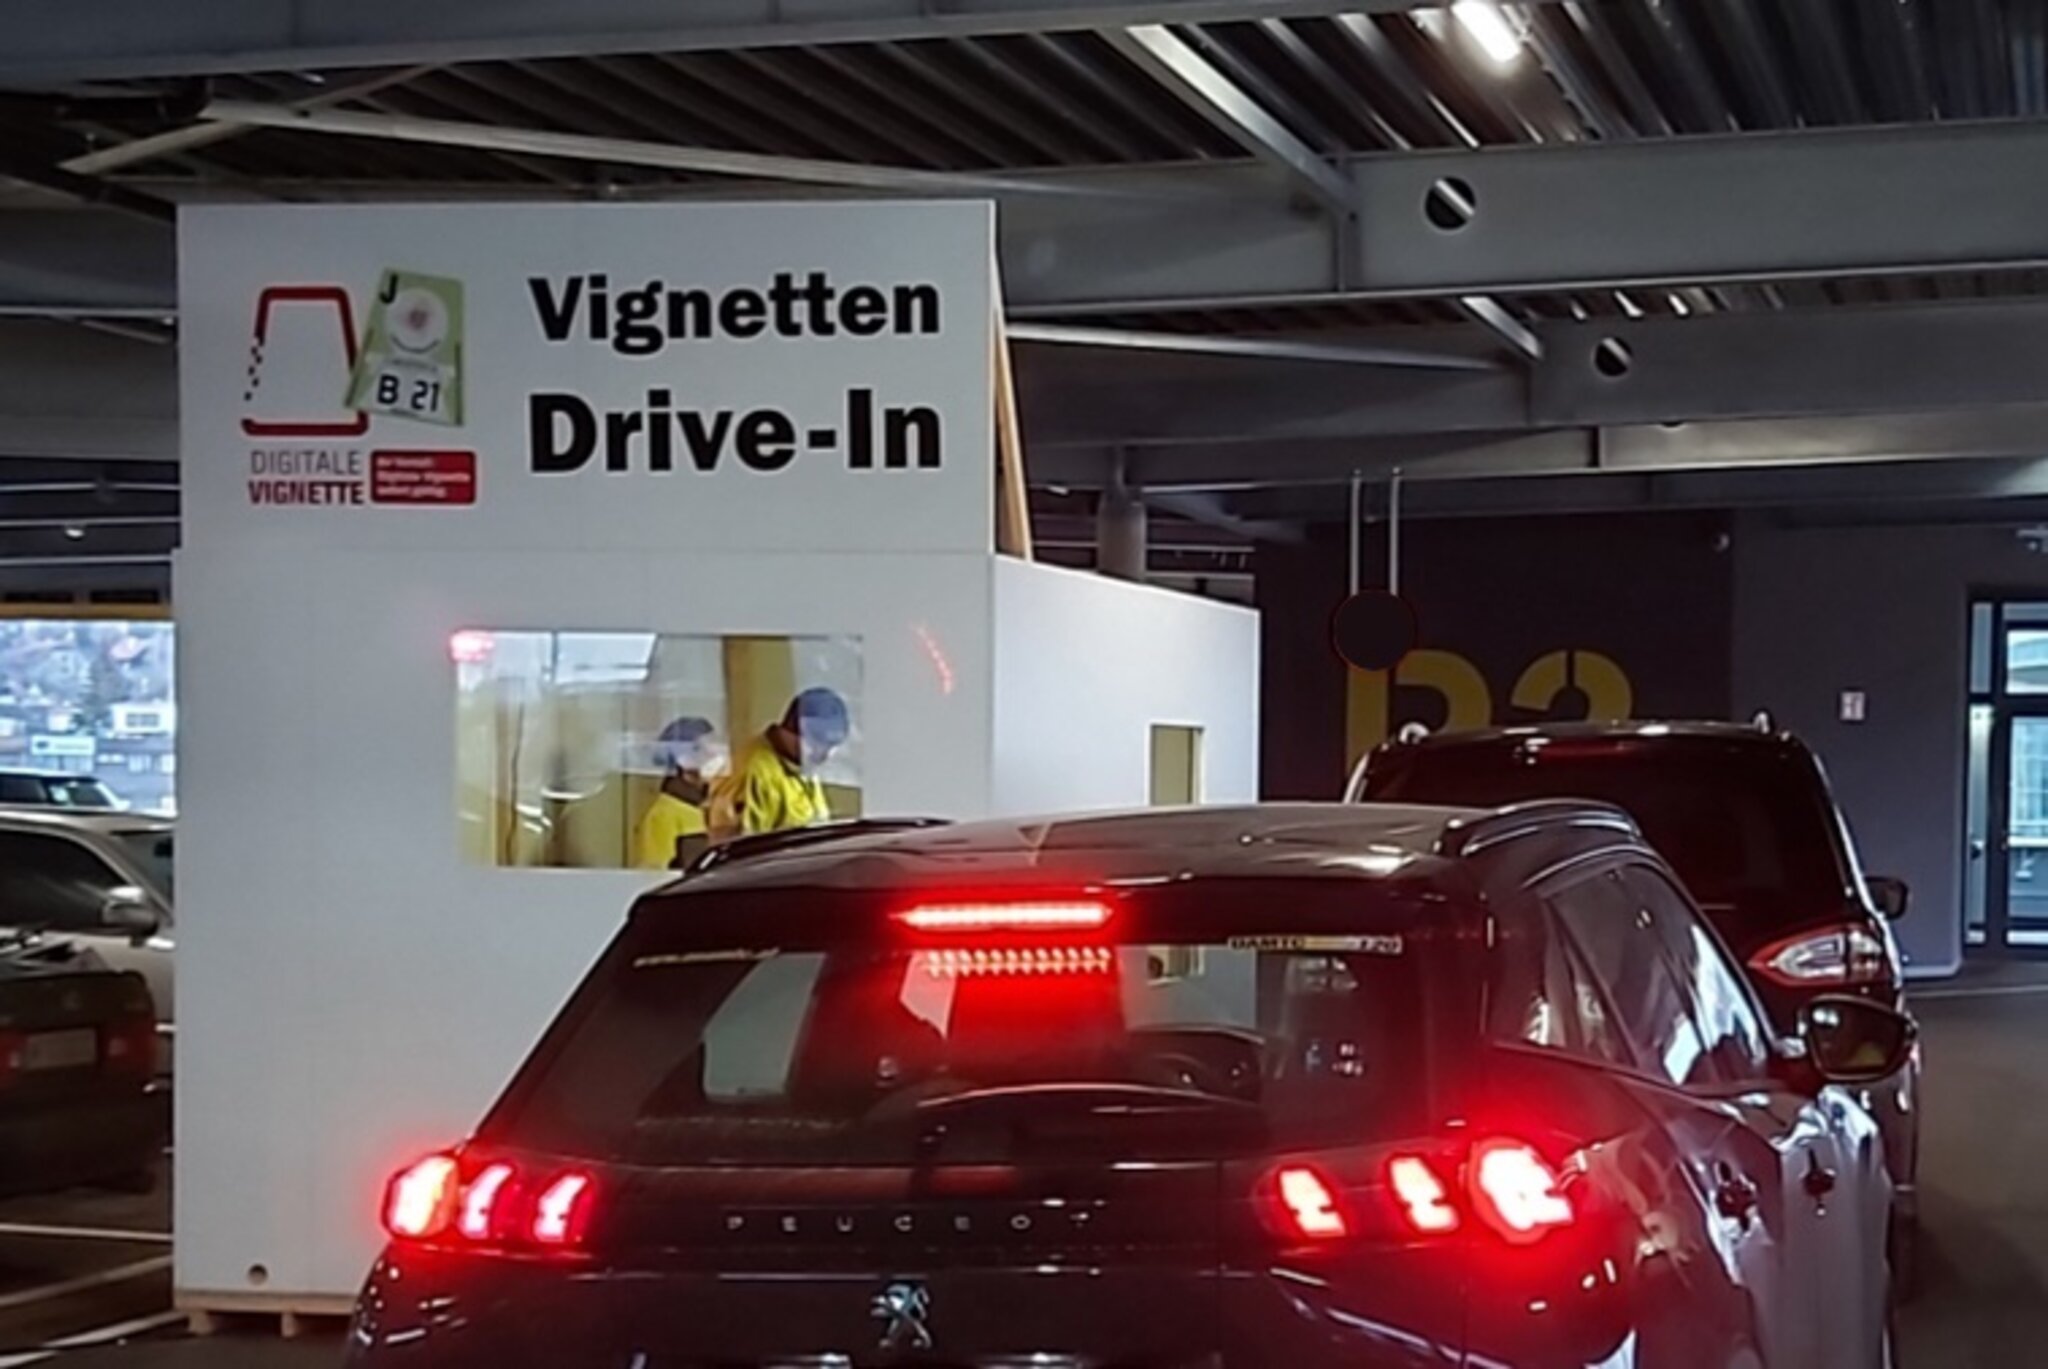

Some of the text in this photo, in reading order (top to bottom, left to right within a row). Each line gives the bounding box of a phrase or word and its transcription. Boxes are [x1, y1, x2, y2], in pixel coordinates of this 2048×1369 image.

[379, 274, 399, 304] J
[528, 273, 940, 355] Vignetten
[377, 374, 440, 412] B 21
[530, 389, 941, 473] Drive-In
[251, 451, 363, 475] DIGITALE
[249, 481, 364, 505] VIGNETTE
